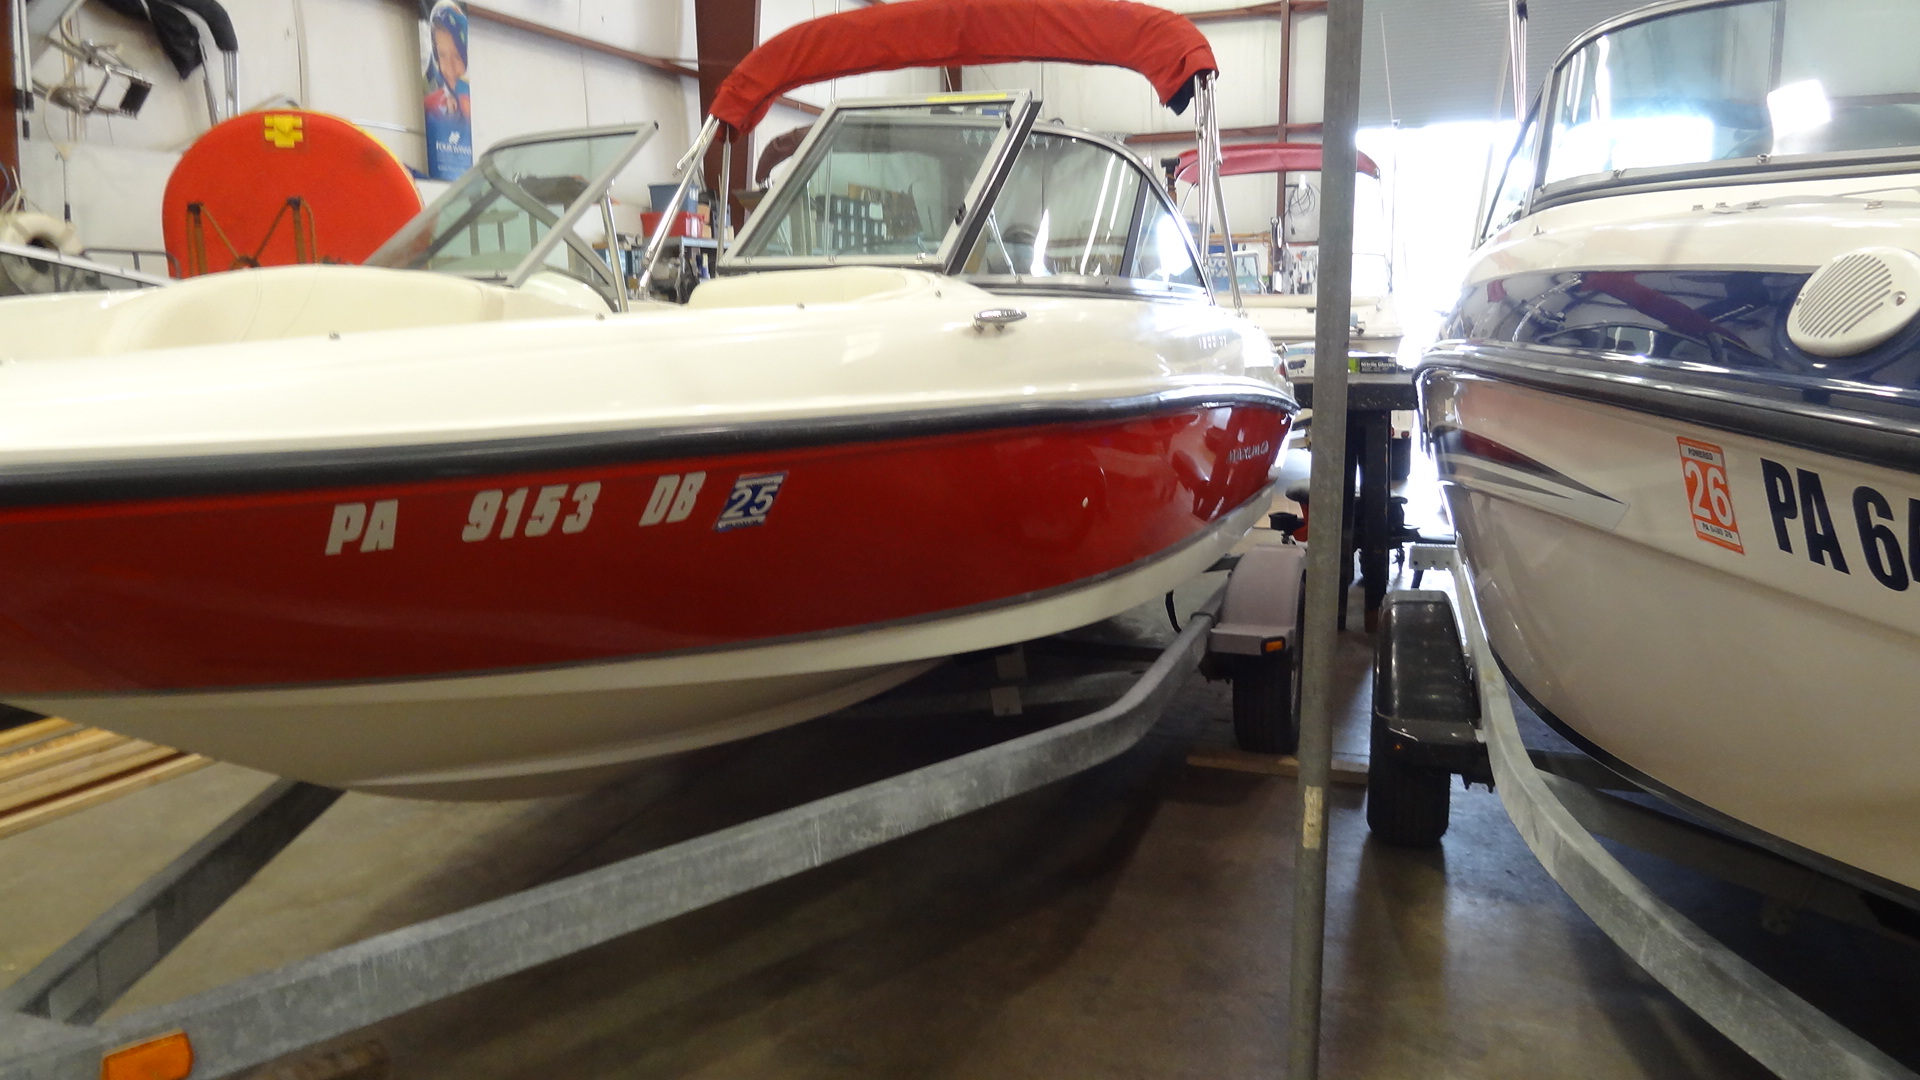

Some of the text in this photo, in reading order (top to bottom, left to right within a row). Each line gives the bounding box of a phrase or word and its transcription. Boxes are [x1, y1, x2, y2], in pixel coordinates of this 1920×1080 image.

[324, 471, 707, 556] PA 9153 DB
[720, 485, 778, 518] 25
[1685, 460, 1733, 527] 26
[1760, 457, 1851, 575] PA
